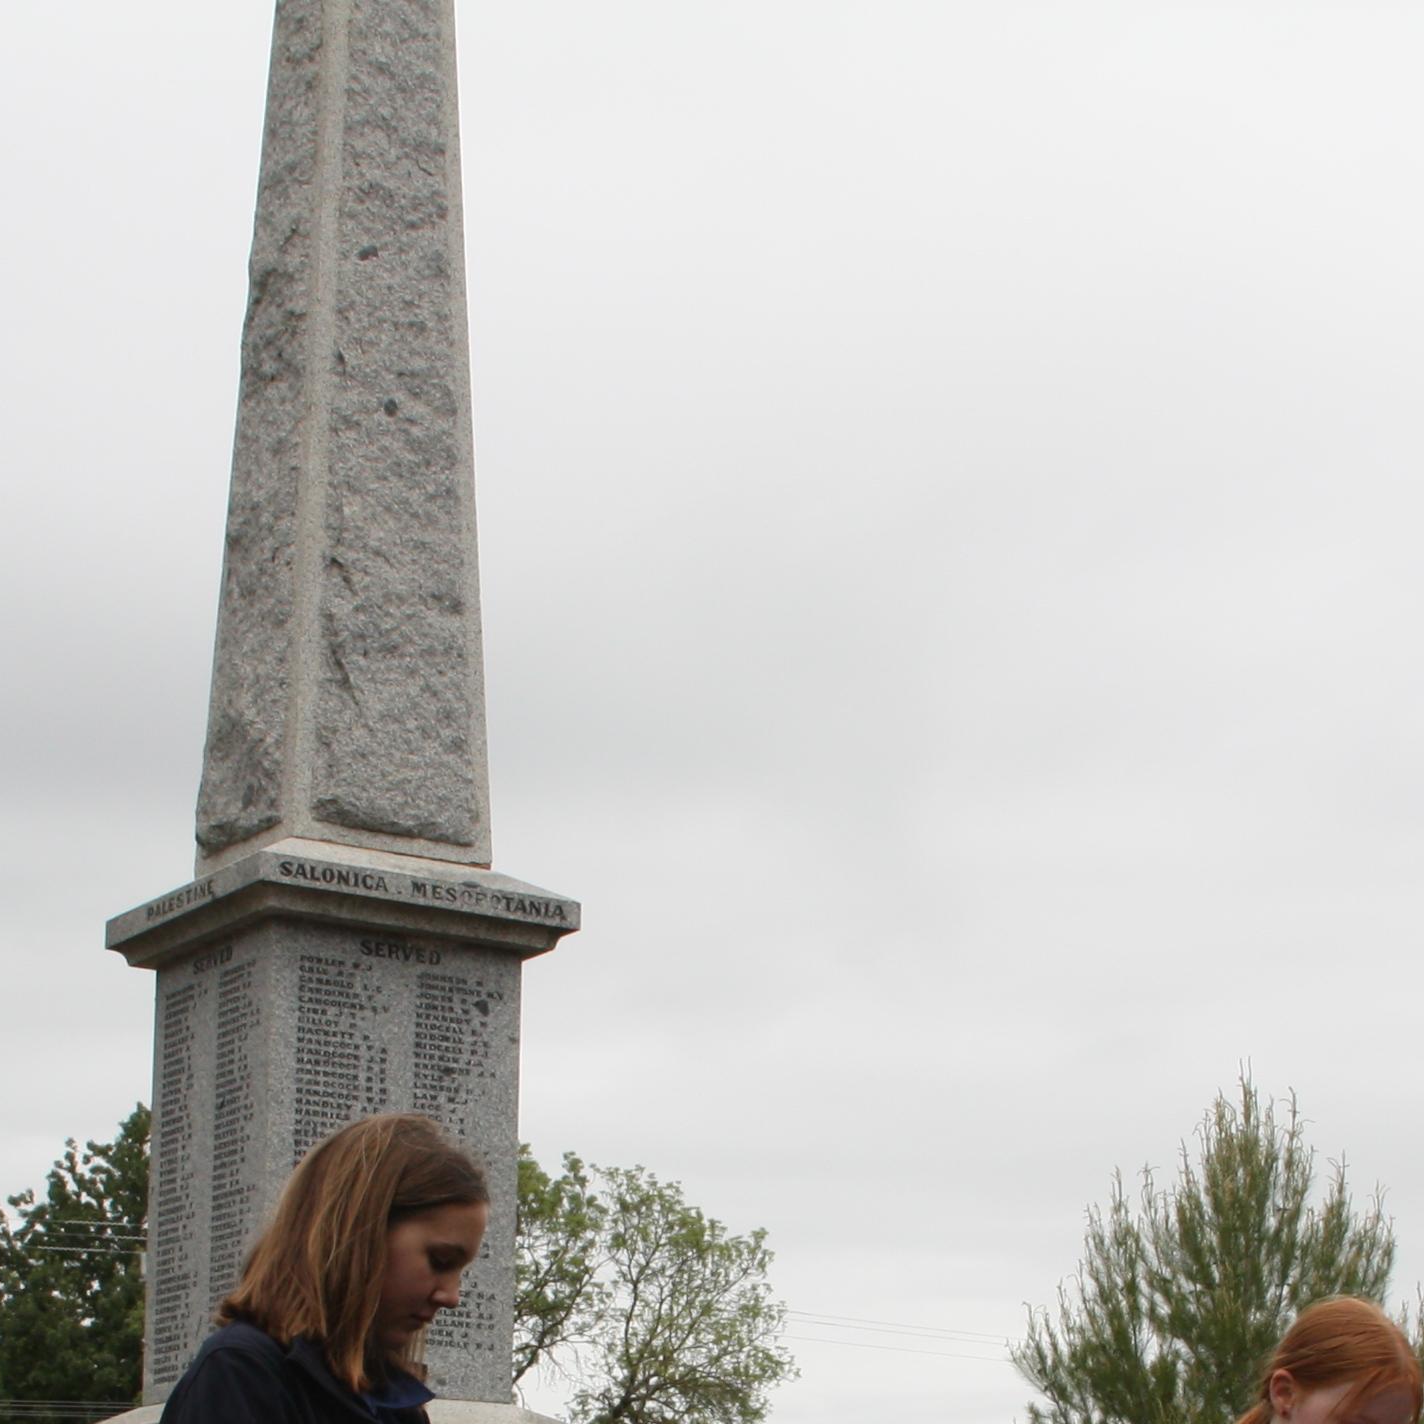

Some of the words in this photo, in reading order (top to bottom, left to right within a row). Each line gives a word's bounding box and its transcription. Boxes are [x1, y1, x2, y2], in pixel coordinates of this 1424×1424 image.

[279, 861, 389, 893] SALONICA
[146, 878, 216, 922] PALESTINE
[359, 939, 442, 966] SERVED
[295, 1095, 352, 1112] HANDLEY
